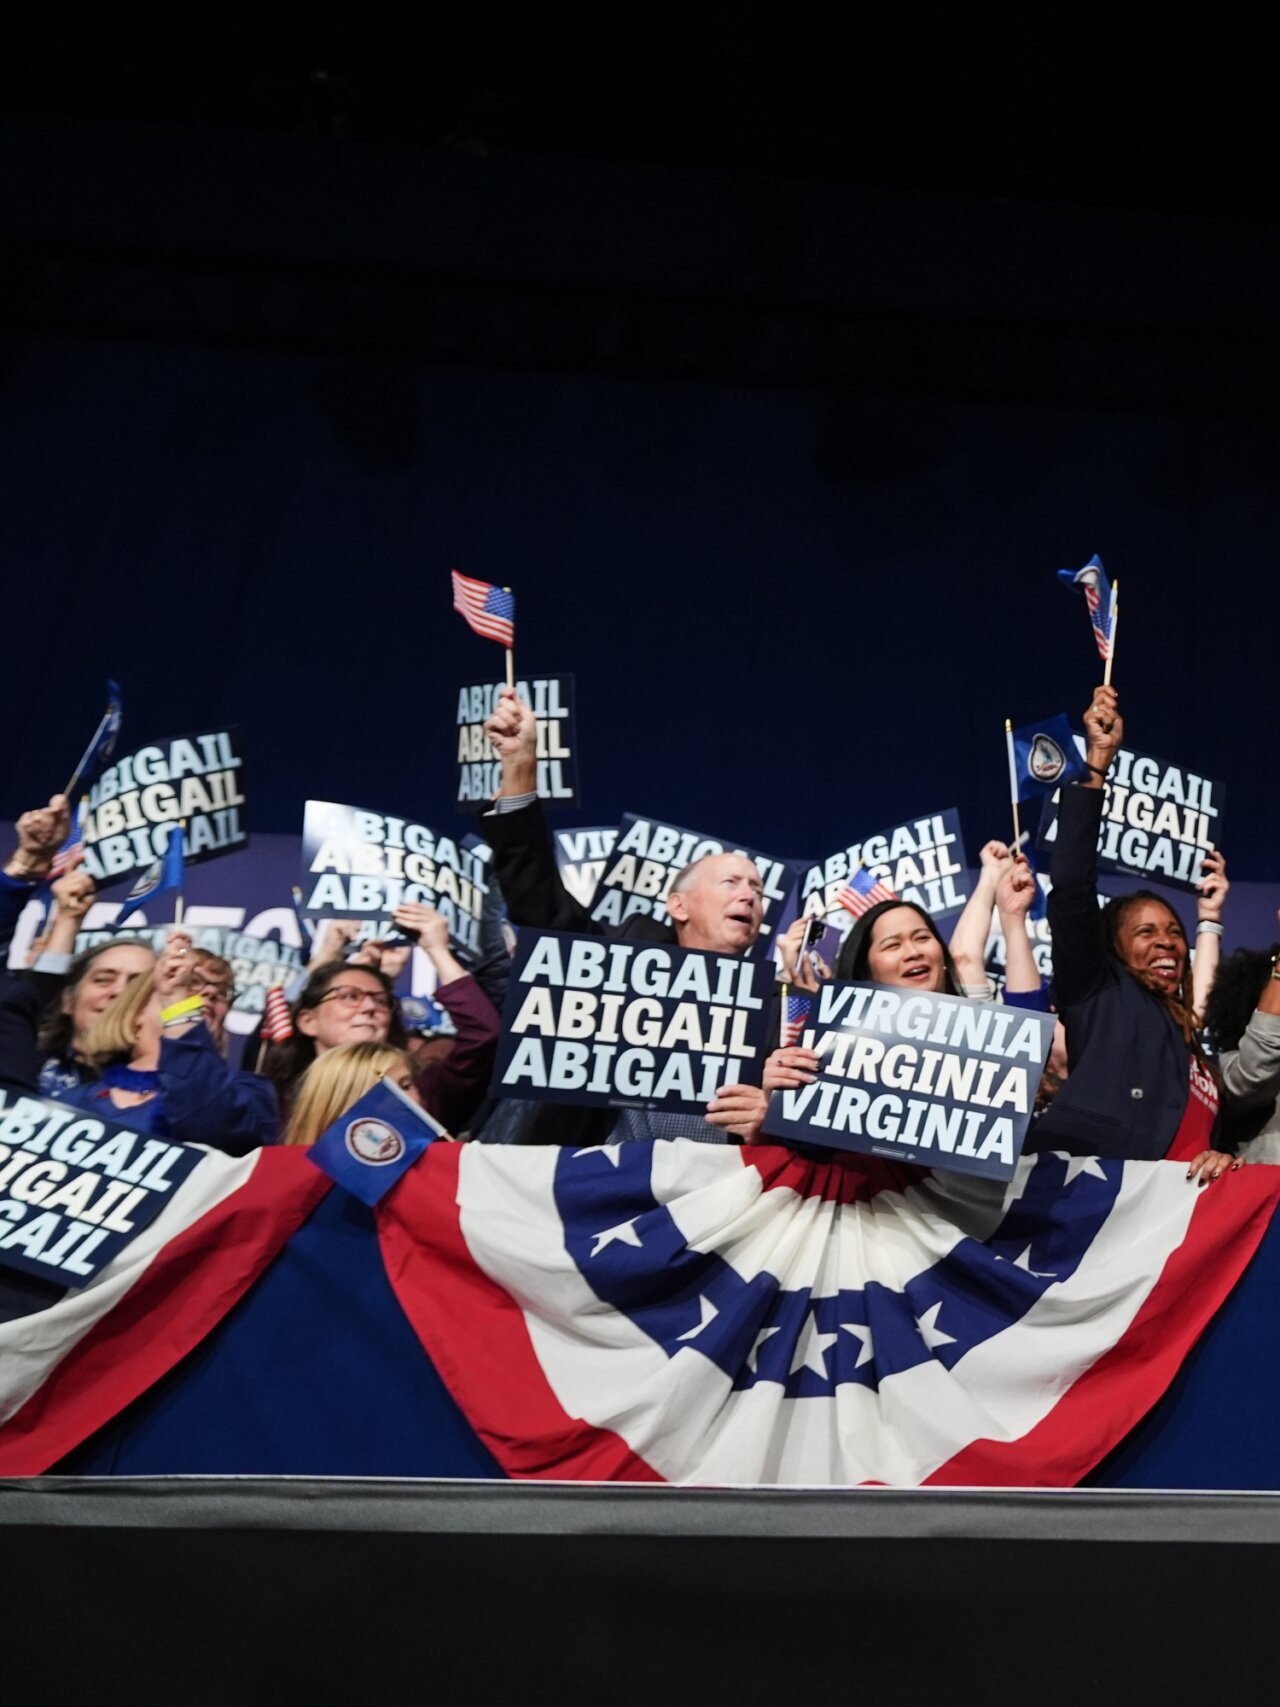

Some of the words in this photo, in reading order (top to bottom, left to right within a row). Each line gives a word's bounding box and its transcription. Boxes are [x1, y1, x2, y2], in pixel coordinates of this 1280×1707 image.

[802, 815, 956, 899] ABIGAIL
[519, 936, 763, 1010] ABIGAIL
[510, 986, 757, 1058] ABIGAIL
[818, 985, 1043, 1063] VIRGINIA
[782, 1080, 1015, 1165] VIRGINIA
